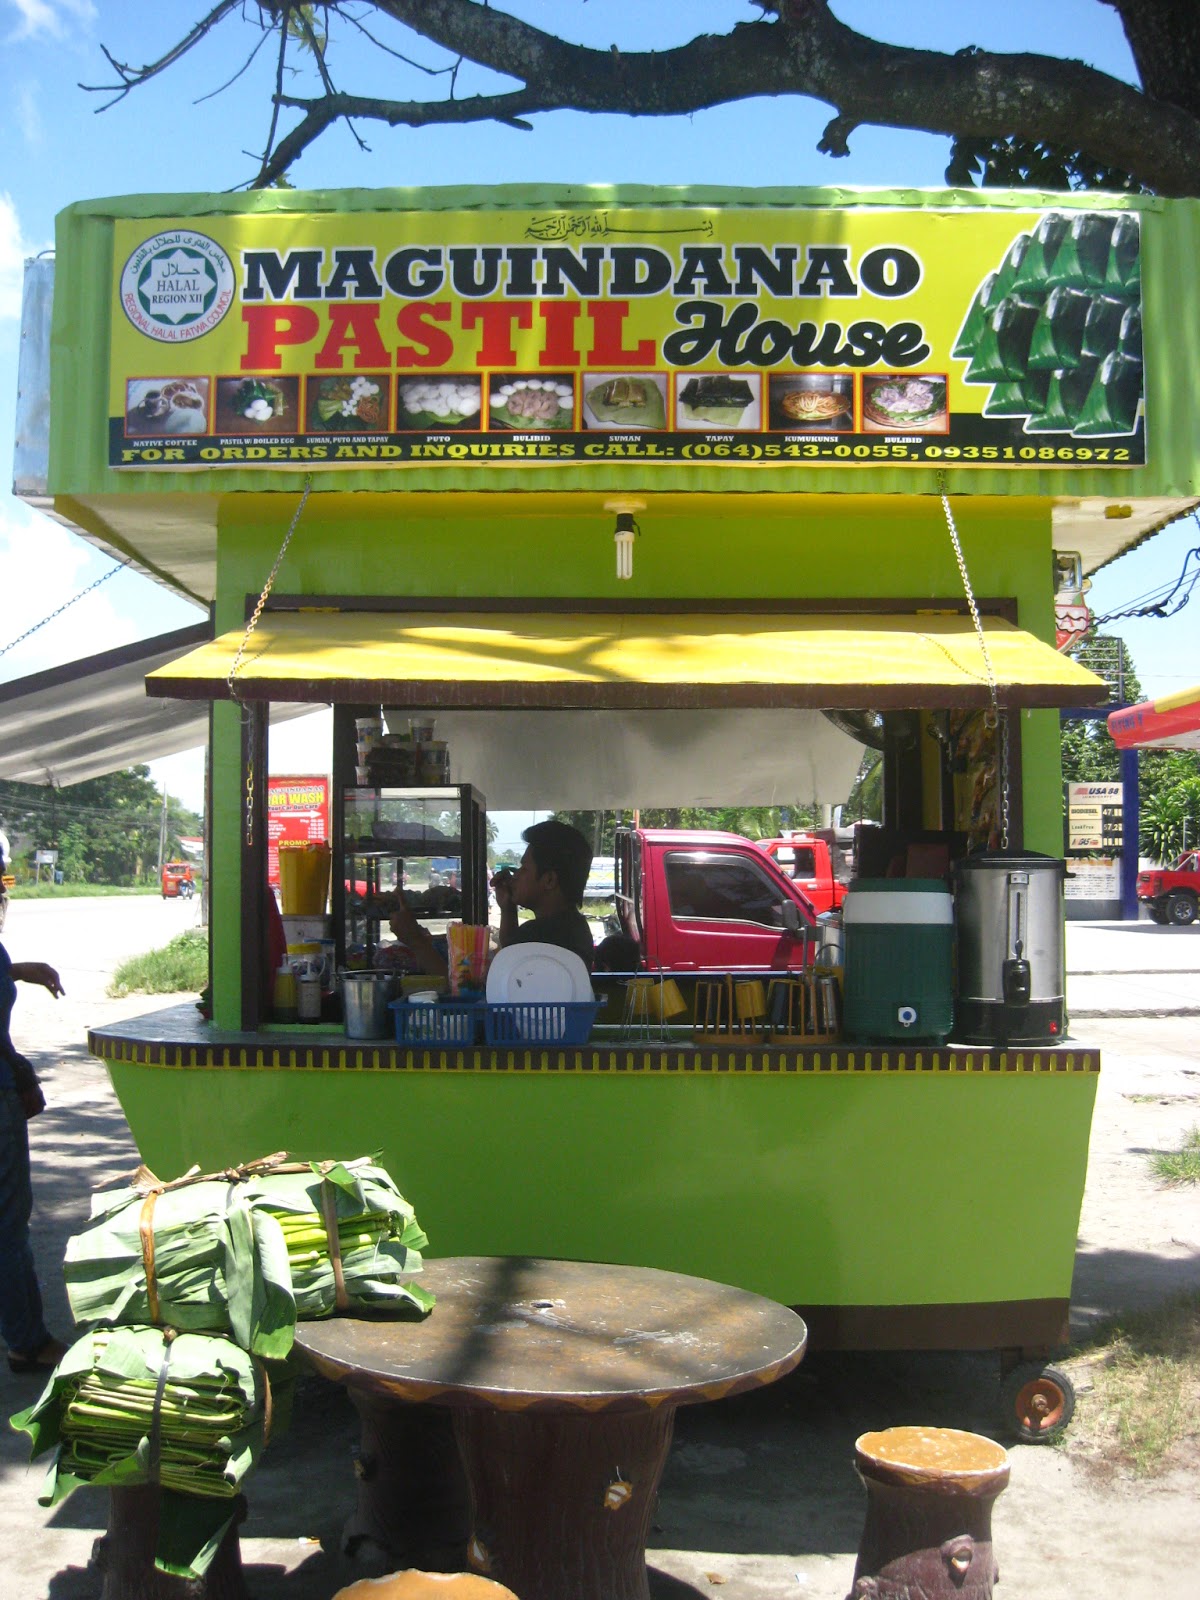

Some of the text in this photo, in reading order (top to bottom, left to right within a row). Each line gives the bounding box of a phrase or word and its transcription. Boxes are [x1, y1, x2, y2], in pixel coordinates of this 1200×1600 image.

[241, 247, 921, 300] MAGUINDANAO
[156, 280, 200, 292] HALAL
[152, 294, 202, 304] REGION XII
[124, 289, 232, 340] REGIONAL HALAL FATWA COUNCIL
[240, 300, 931, 370] PASTIL House
[165, 439, 198, 447] COFFEE
[220, 438, 246, 446] PASTIL
[253, 437, 278, 445] BOILED
[306, 437, 332, 445] SUMAN,
[512, 435, 551, 443] BULIBID
[784, 435, 839, 443] KUMUKUNSI
[884, 436, 923, 444] BULIBID
[121, 448, 186, 462] FOR
[200, 446, 328, 460] ORDERS
[335, 445, 402, 458] AND
[410, 443, 576, 459] INQUIRIES
[584, 443, 675, 456] CALL:
[924, 446, 1130, 461] 09351086972
[269, 785, 325, 795] AGUINDANAO
[289, 791, 324, 804] WASH
